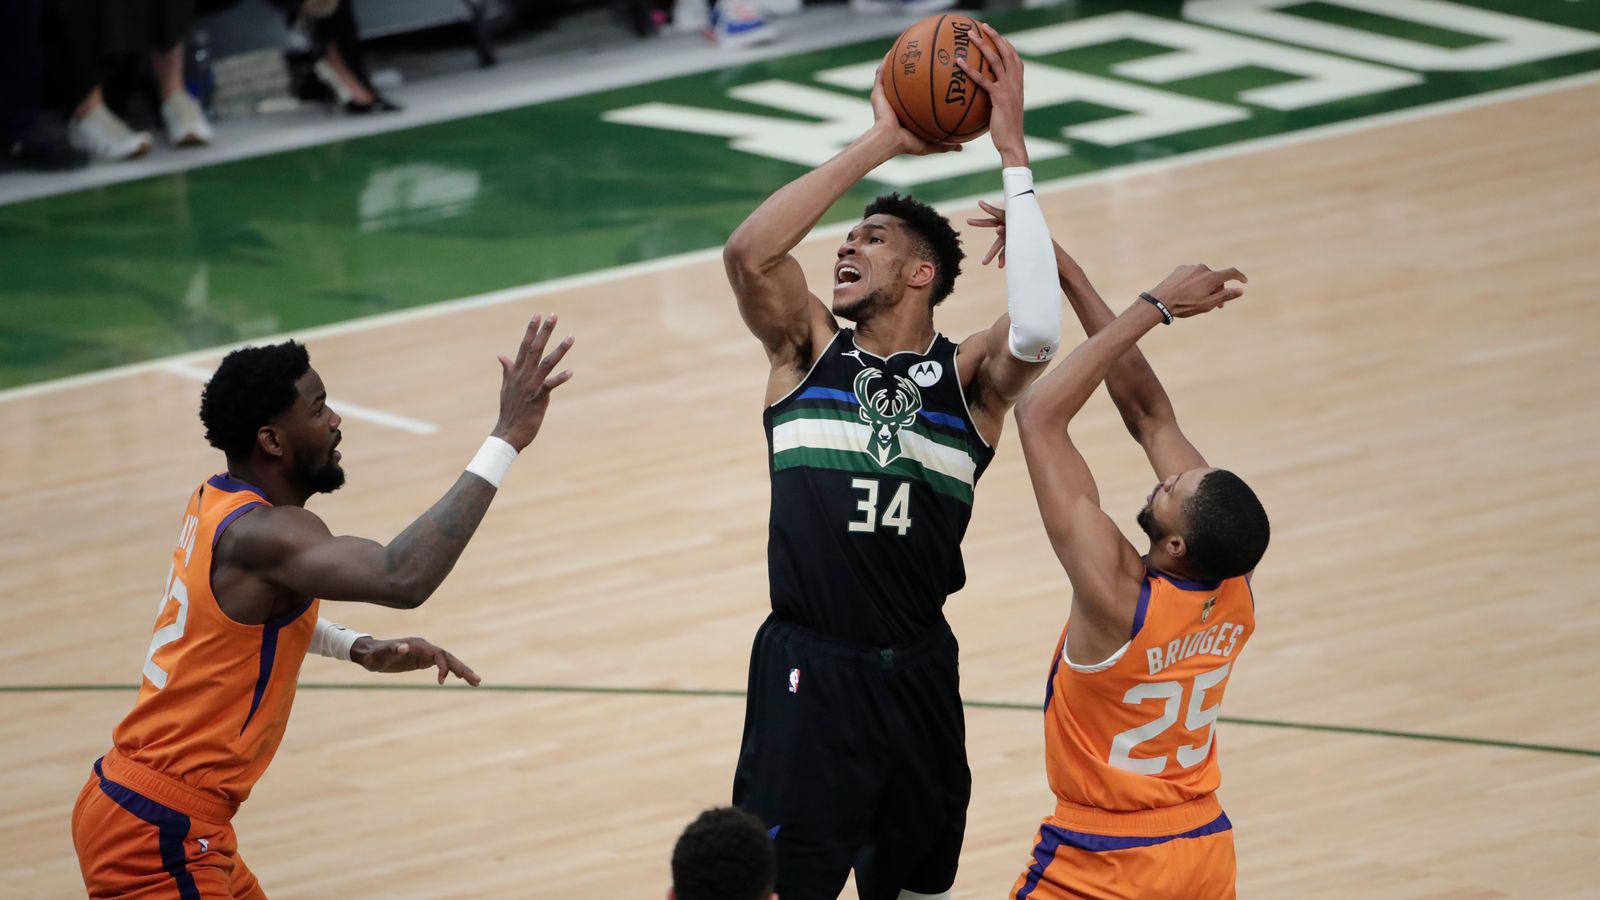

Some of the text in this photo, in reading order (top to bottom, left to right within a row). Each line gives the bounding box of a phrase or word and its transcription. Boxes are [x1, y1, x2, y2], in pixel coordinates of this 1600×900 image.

[848, 478, 912, 536] 34
[1146, 622, 1244, 676] BRIDGES
[1108, 662, 1231, 776] 25
